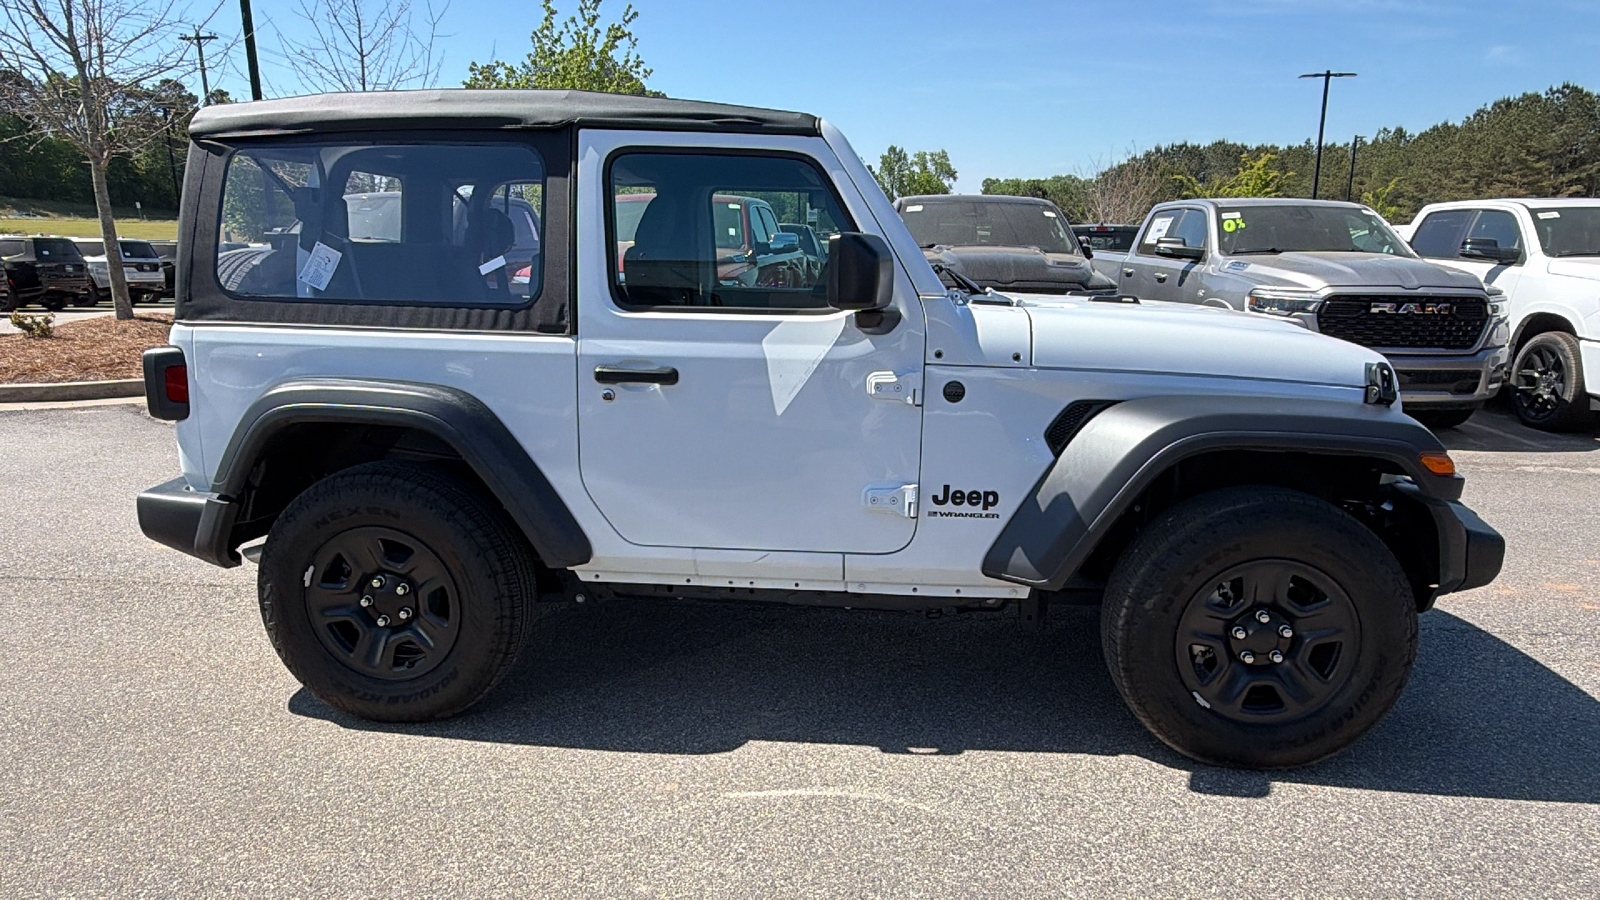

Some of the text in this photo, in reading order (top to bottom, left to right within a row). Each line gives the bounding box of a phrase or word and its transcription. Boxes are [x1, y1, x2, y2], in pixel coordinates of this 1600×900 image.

[1223, 218, 1246, 233] 0%
[1370, 302, 1451, 315] RAM
[931, 484, 999, 511] Jeep
[938, 511, 1000, 519] WRANGLER
